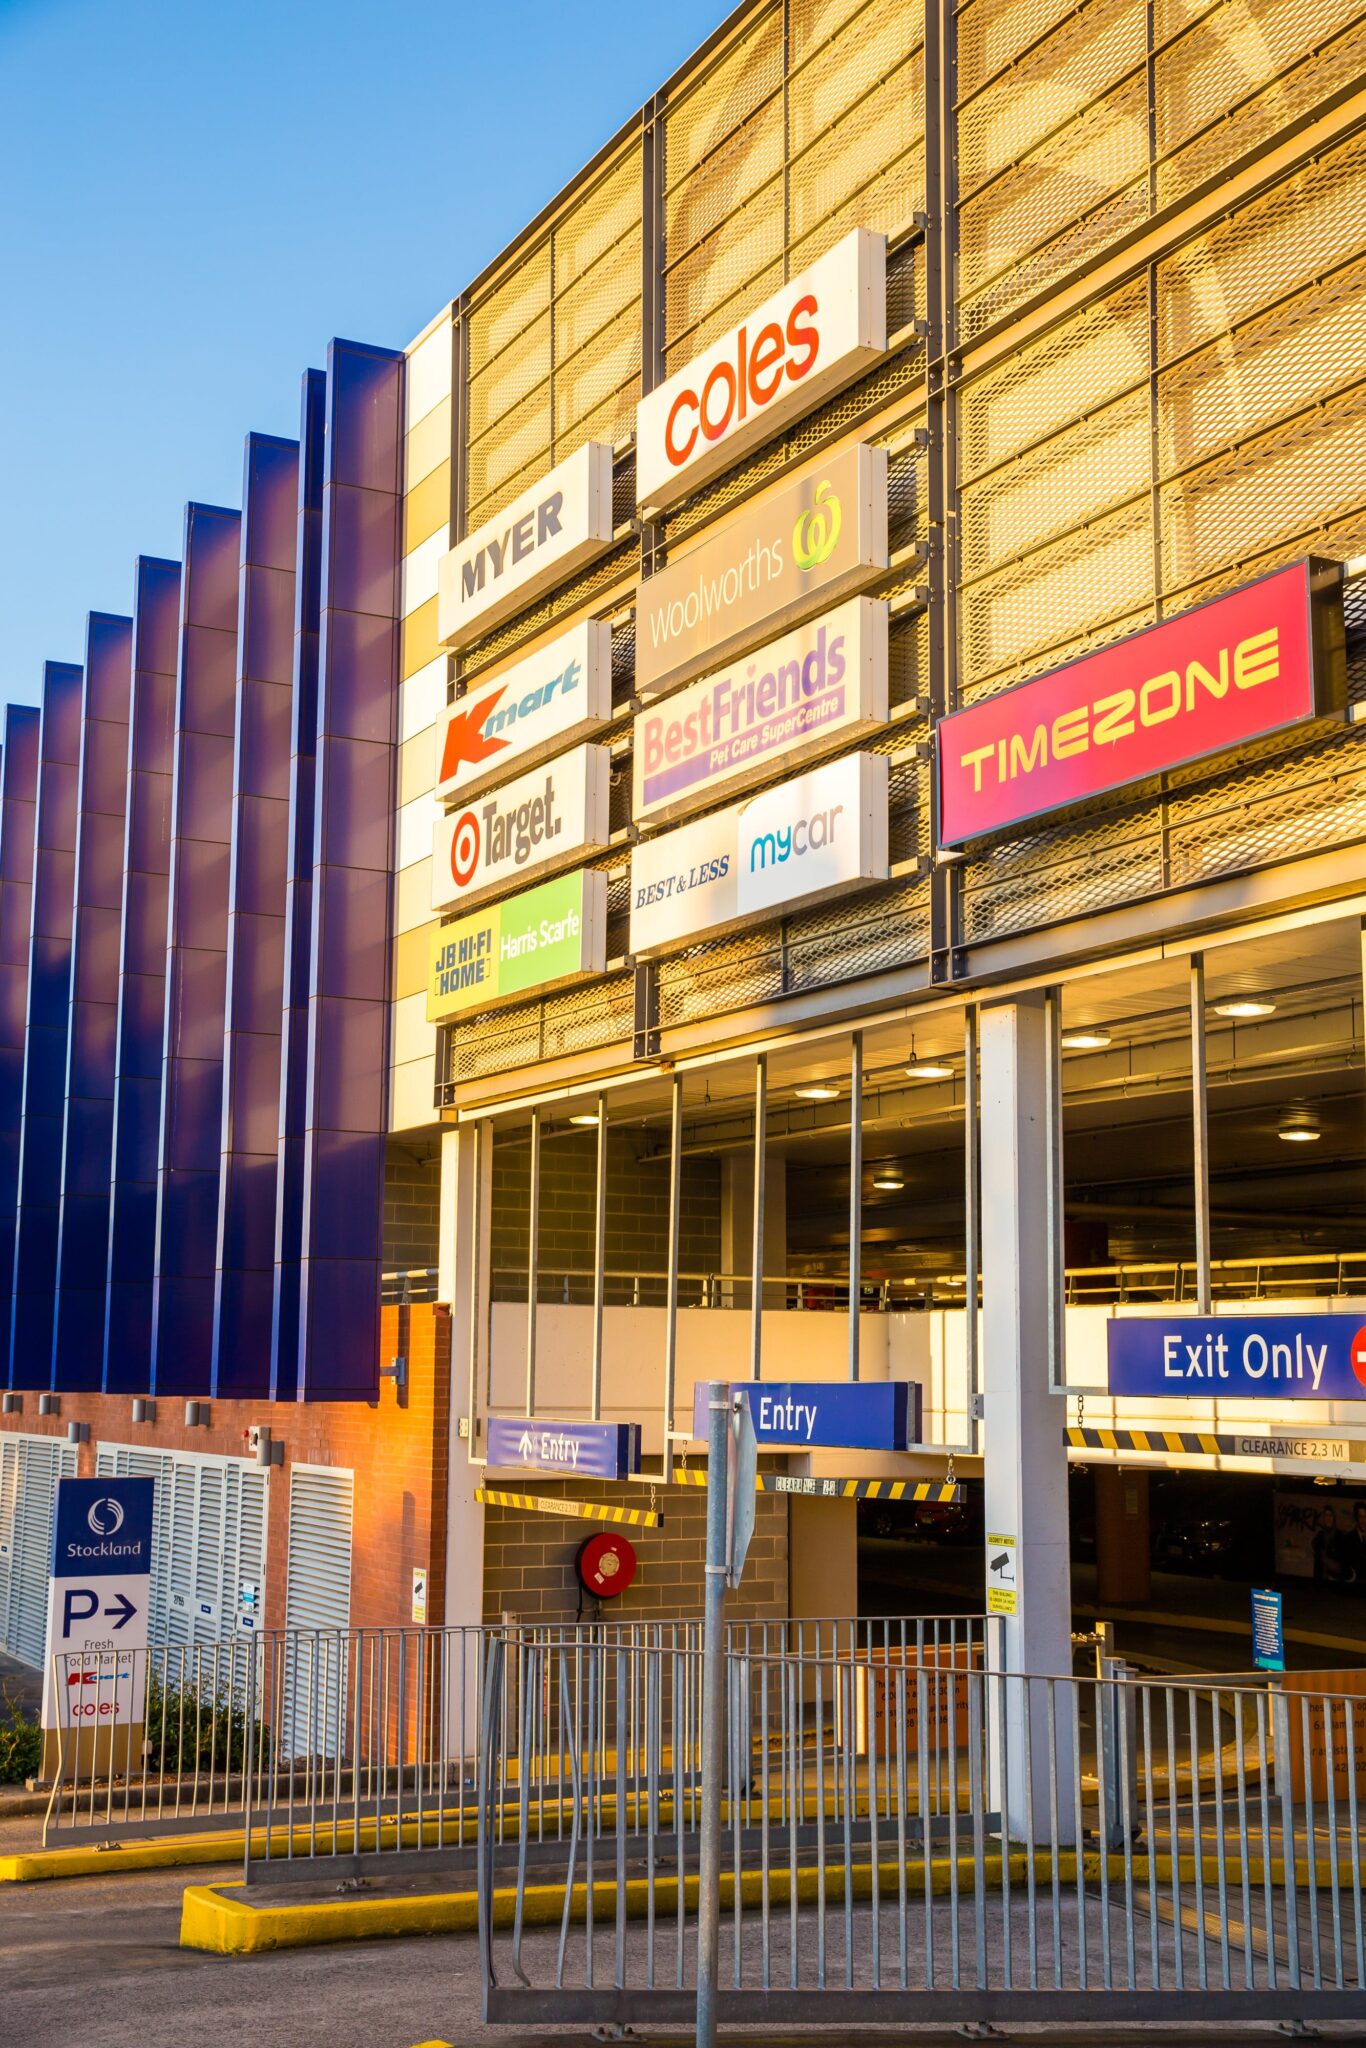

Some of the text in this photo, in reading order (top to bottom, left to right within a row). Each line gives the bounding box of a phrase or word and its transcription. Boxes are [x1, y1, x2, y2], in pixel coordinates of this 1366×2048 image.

[664, 294, 820, 467] coles
[461, 490, 564, 603] MYER
[439, 658, 582, 784] Kmart
[709, 696, 838, 769] Pet Care SuperCentre
[960, 626, 1280, 793] TIMEZONE
[750, 804, 844, 873] mycar
[635, 854, 730, 910] BEST & LESS
[435, 942, 457, 973] JB
[500, 908, 579, 962] Harris Scarfe
[1163, 1333, 1328, 1391] Exit Only
[759, 1396, 817, 1440] Entry
[540, 1431, 580, 1469] Entry
[1241, 1439, 1343, 1458] CLEARANCE 2.3 M
[776, 1477, 816, 1493] CLEARANCE
[67, 1541, 141, 1557] Stockland
[62, 1589, 100, 1639] P
[84, 1639, 114, 1651] Fresh
[72, 1702, 120, 1717] coes
